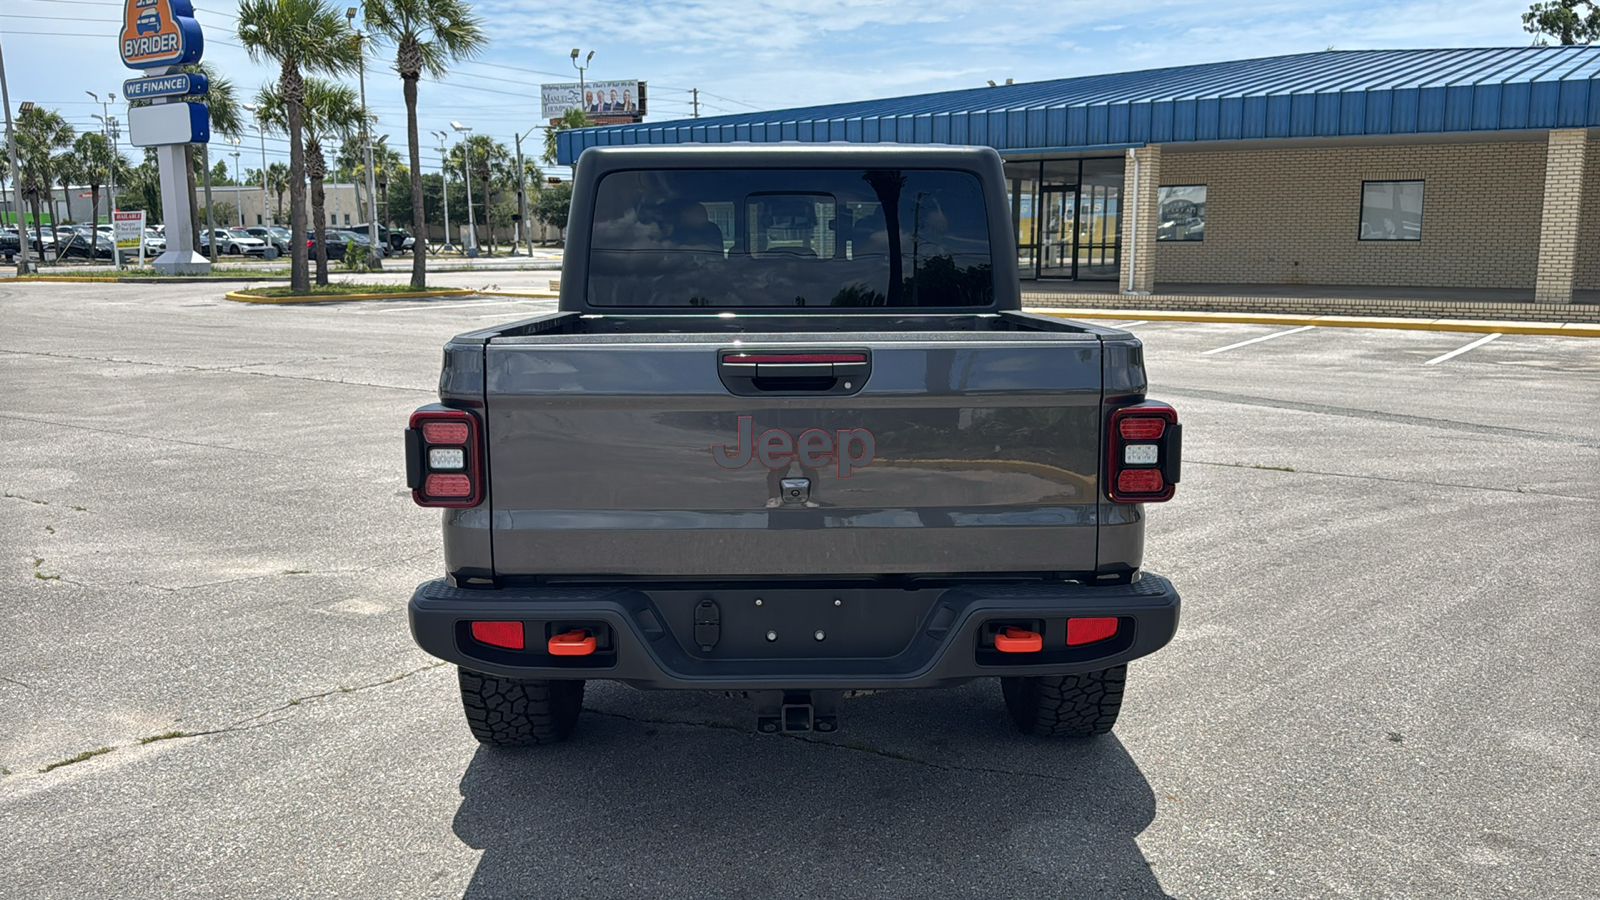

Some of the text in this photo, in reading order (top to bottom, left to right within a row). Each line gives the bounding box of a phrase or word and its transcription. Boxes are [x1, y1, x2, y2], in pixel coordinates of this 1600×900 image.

[125, 33, 178, 57] BYRIDER
[127, 78, 186, 94] WE FINANCE!
[576, 82, 592, 90] Peple,
[711, 416, 876, 480] Jeep
